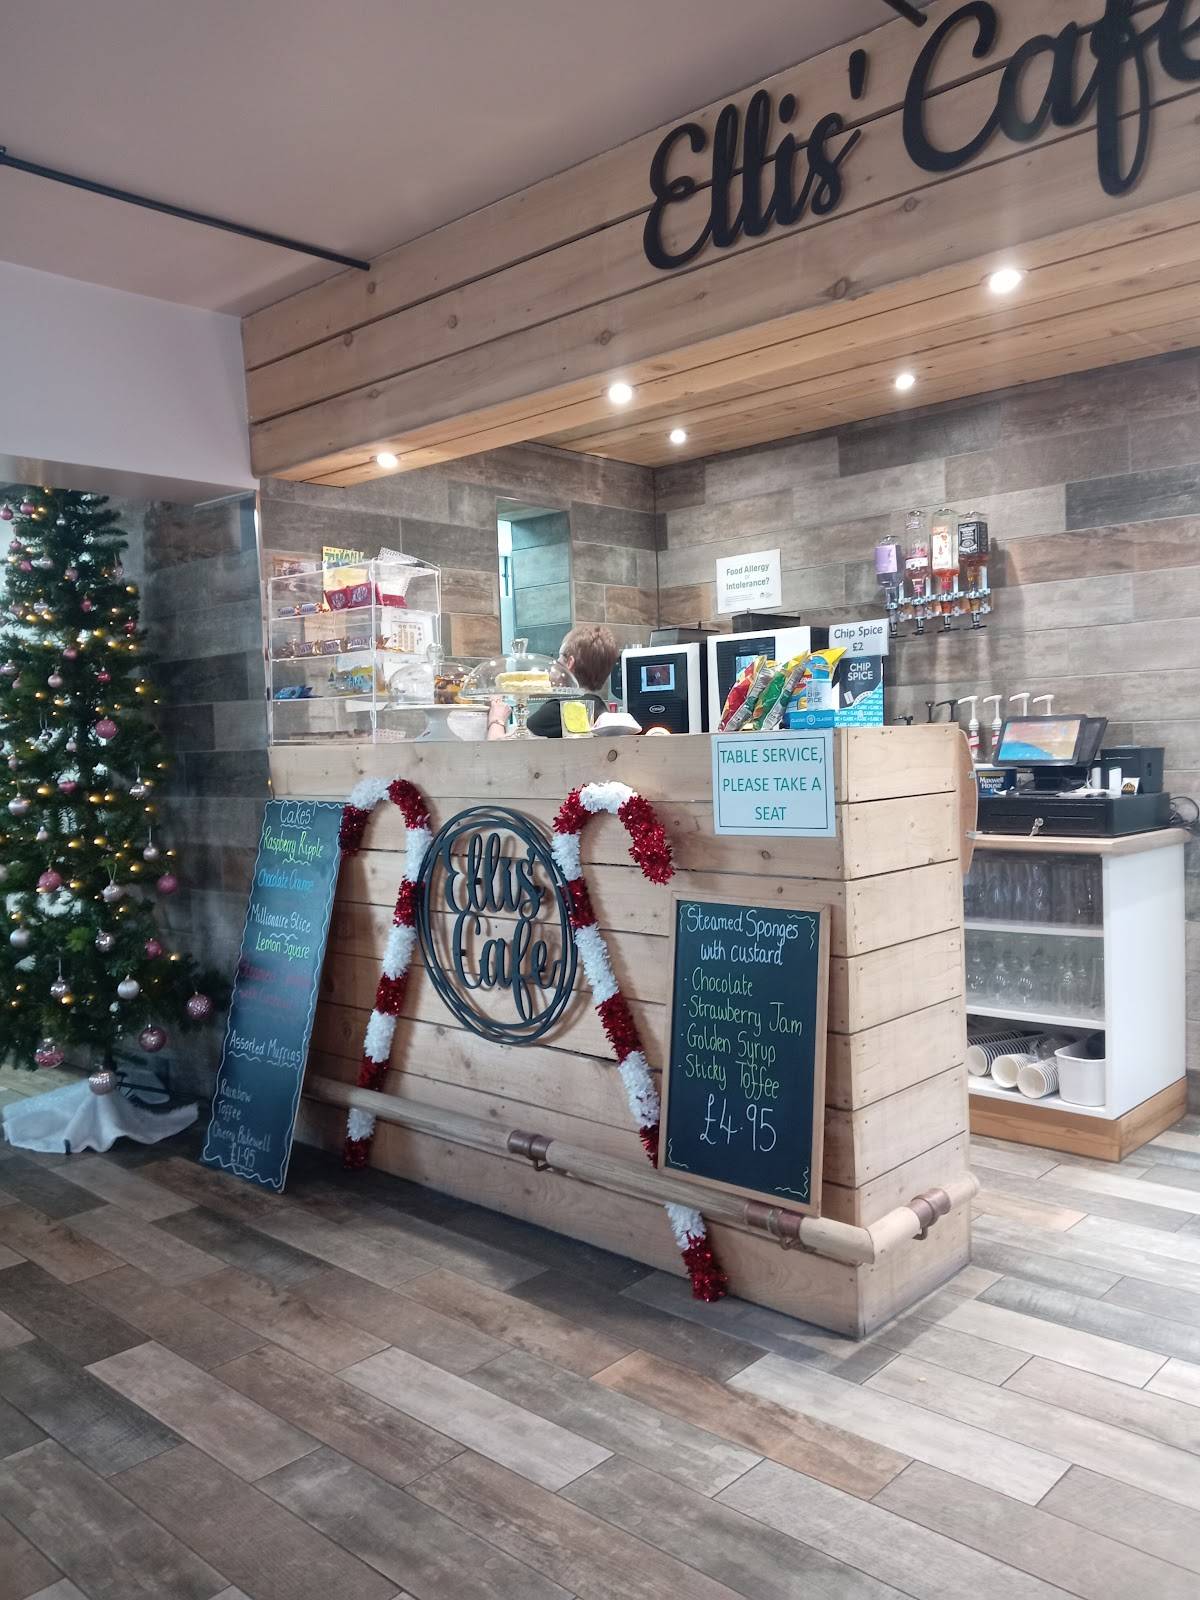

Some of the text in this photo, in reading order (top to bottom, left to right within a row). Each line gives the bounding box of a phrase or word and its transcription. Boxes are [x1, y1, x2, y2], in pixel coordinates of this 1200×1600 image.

[727, 564, 769, 576] Food Allergy
[726, 577, 770, 591] Intolerance?
[834, 626, 883, 642] Chip Spice
[852, 642, 864, 652] £2
[848, 672, 873, 681] SPICE
[851, 662, 871, 672] CHIP
[720, 747, 823, 764] TABLE SERVICE,
[723, 776, 822, 792] PLEASE TAKE A
[755, 806, 787, 821] SEAT
[263, 826, 325, 862] Raspberry Ripple
[250, 903, 312, 934] Millionaire Slice
[686, 906, 799, 943] Steamed Sponges
[256, 931, 311, 962] Lemon Square
[700, 940, 784, 966] with custard
[692, 967, 753, 997] Chocolate
[688, 995, 802, 1037] Strawberry Jam
[229, 1029, 301, 1063] Assorted Muffins
[686, 1023, 776, 1067] Golden Syrup
[685, 1054, 780, 1101] Sticky Toffee
[218, 1100, 242, 1122] Toffee
[699, 1092, 777, 1152] £4.95
